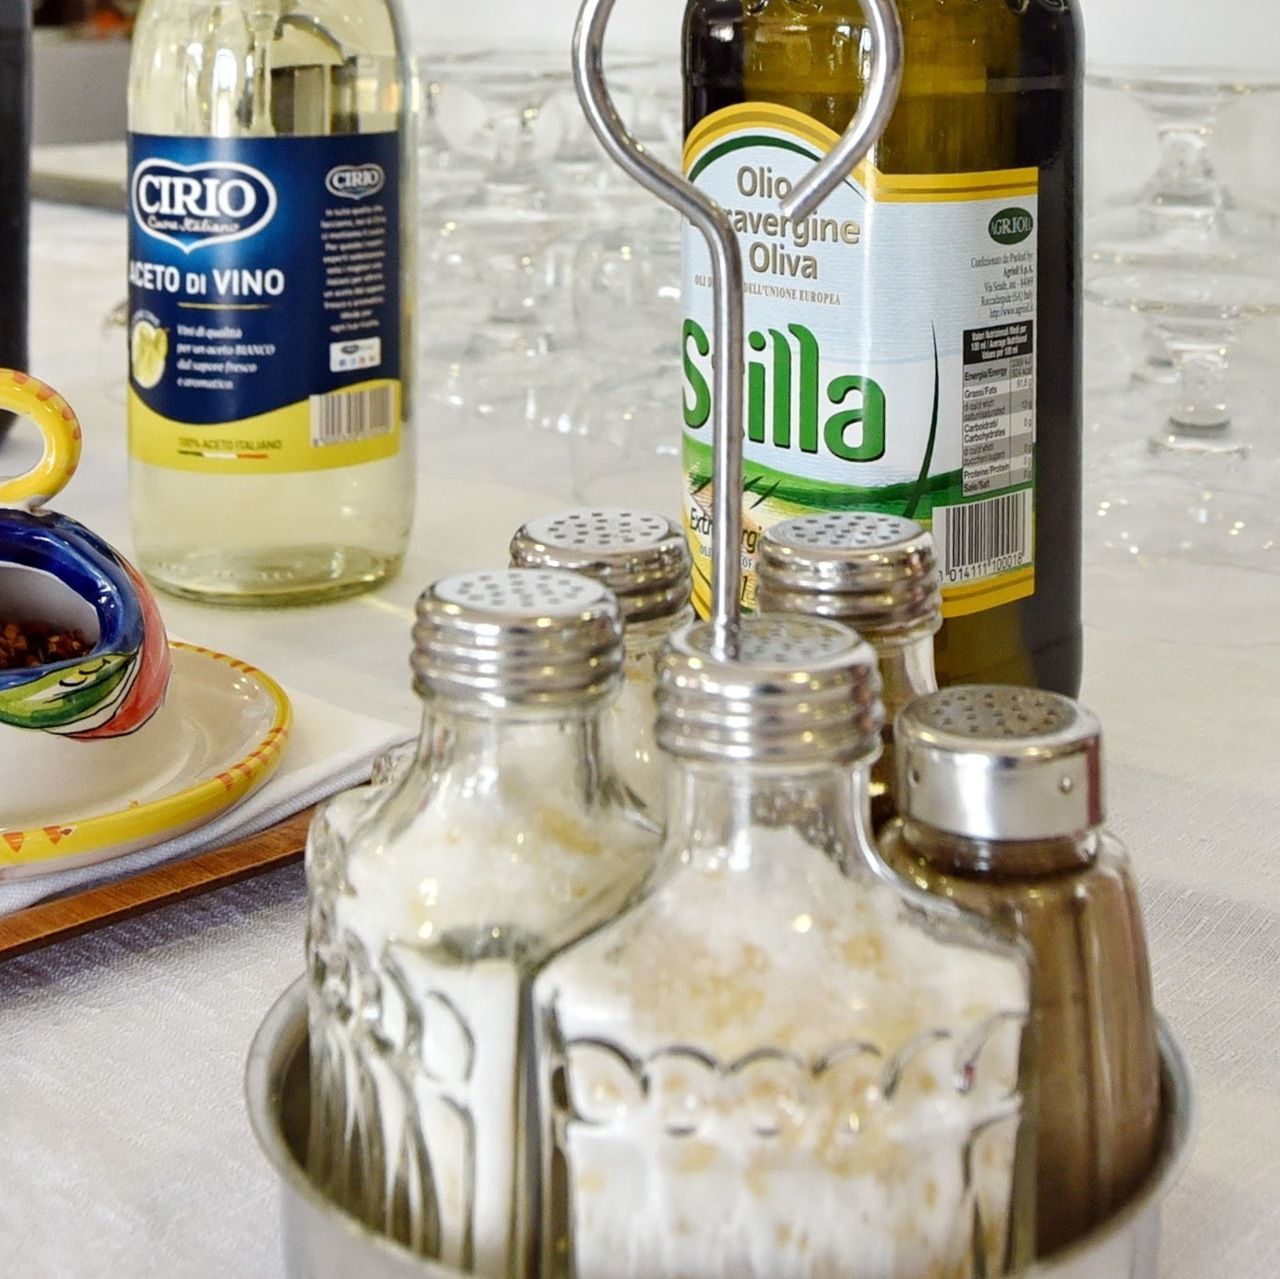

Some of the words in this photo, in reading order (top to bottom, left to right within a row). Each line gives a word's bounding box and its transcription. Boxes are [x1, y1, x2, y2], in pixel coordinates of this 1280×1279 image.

[138, 174, 257, 218] CIRIO
[331, 170, 379, 189] CIRIO
[736, 165, 793, 200] Olio
[749, 241, 819, 280] Oliva
[186, 273, 207, 295] DI
[213, 269, 285, 296] VINO
[743, 282, 798, 301] DELL'UNIONE
[799, 288, 841, 306] EUROPEA
[682, 318, 886, 462] Silla
